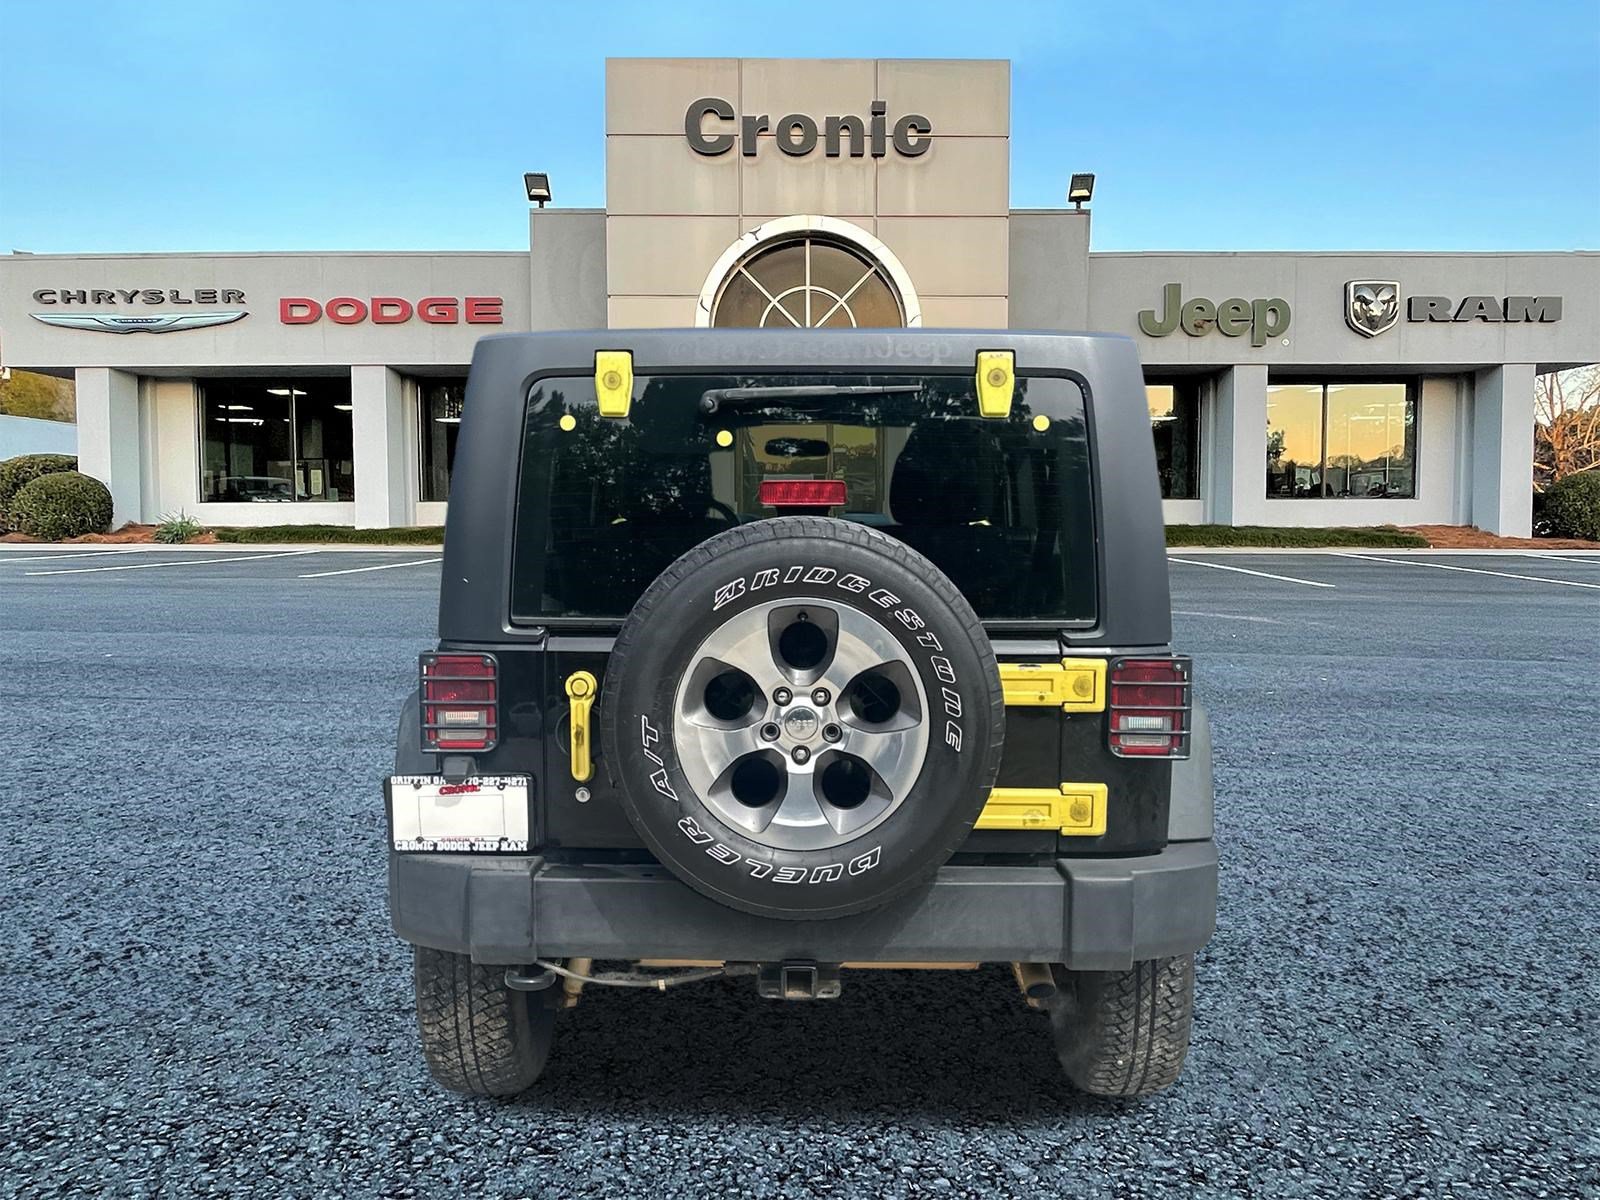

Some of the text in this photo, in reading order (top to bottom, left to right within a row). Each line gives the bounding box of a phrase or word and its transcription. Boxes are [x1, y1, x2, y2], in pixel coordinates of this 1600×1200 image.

[685, 97, 932, 158] Cronic
[32, 288, 246, 305] CHRYSLER
[279, 297, 504, 325] DODGE
[1138, 283, 1291, 347] Jeep
[1407, 296, 1563, 323] RAM
[712, 565, 964, 753] BRIDGESTONE
[641, 714, 882, 885] DUELER A/T
[436, 840, 472, 851] DODGE
